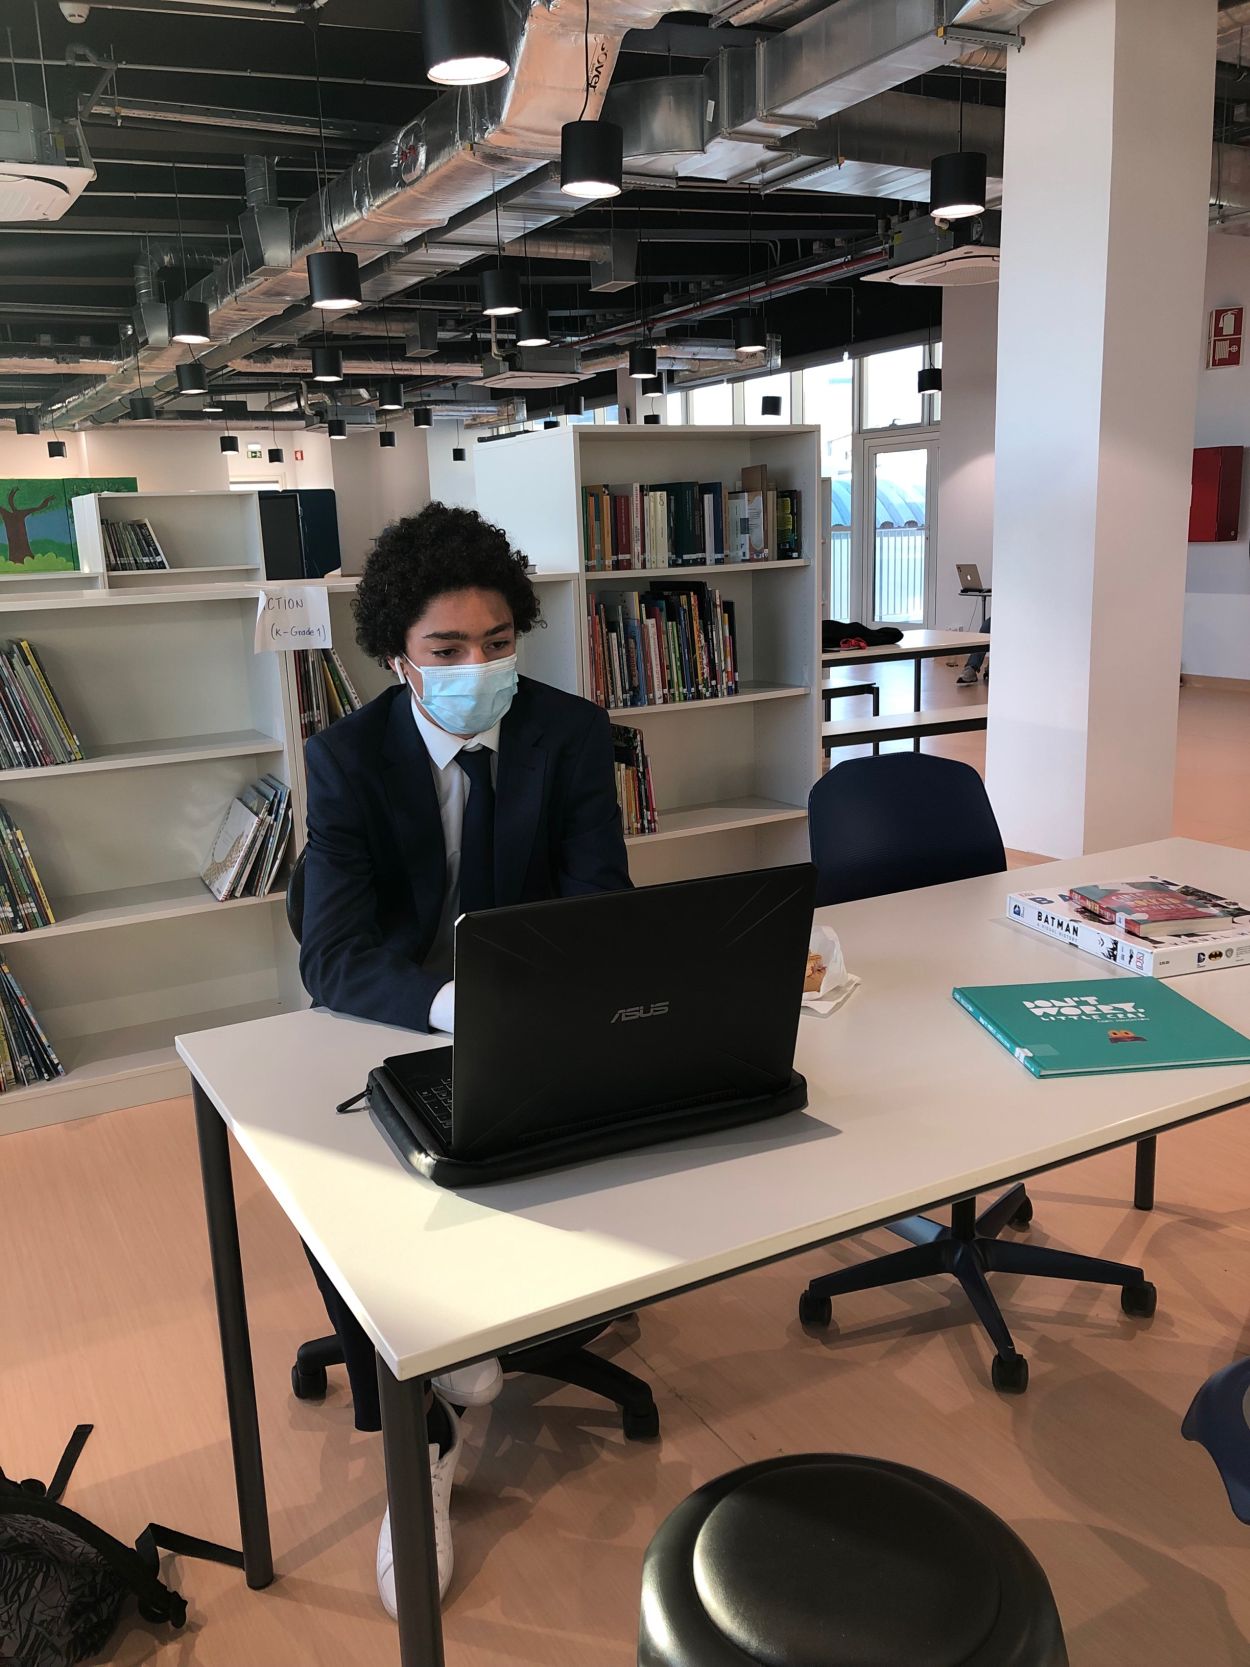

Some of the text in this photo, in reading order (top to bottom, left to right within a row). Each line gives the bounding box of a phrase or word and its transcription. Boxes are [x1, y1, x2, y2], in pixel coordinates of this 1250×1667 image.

[1037, 911, 1079, 937] BATMAN
[610, 1001, 669, 1024] ASUS
[1022, 996, 1099, 1009] DON'T
